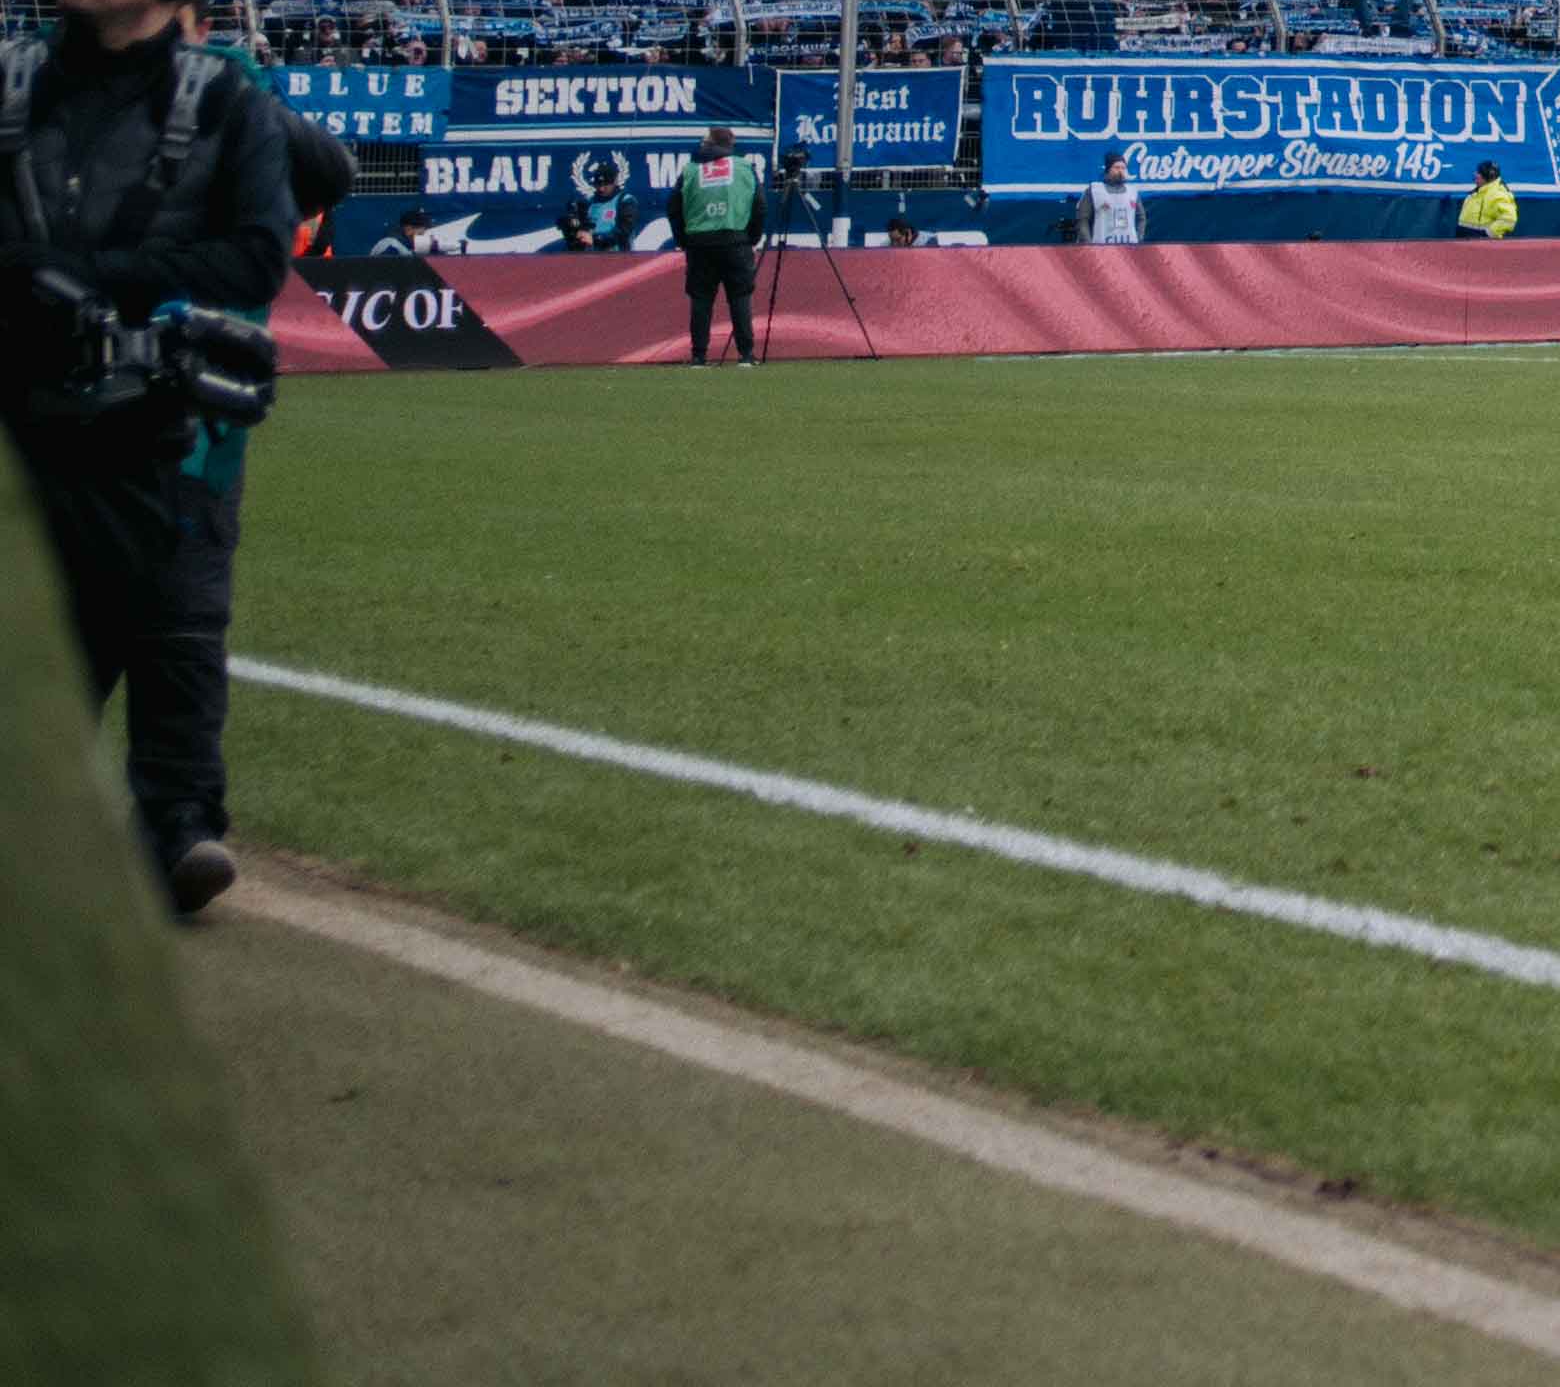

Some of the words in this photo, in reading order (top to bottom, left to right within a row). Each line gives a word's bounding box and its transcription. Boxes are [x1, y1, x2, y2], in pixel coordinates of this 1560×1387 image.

[288, 73, 425, 97] BLUE
[495, 76, 697, 115] SEKTION
[296, 112, 433, 136] YSTEM
[1012, 74, 1527, 143] RUHRSTADION
[424, 154, 552, 195] BLAU
[1123, 142, 1280, 188] Castroper
[1283, 140, 1391, 180] Strasse
